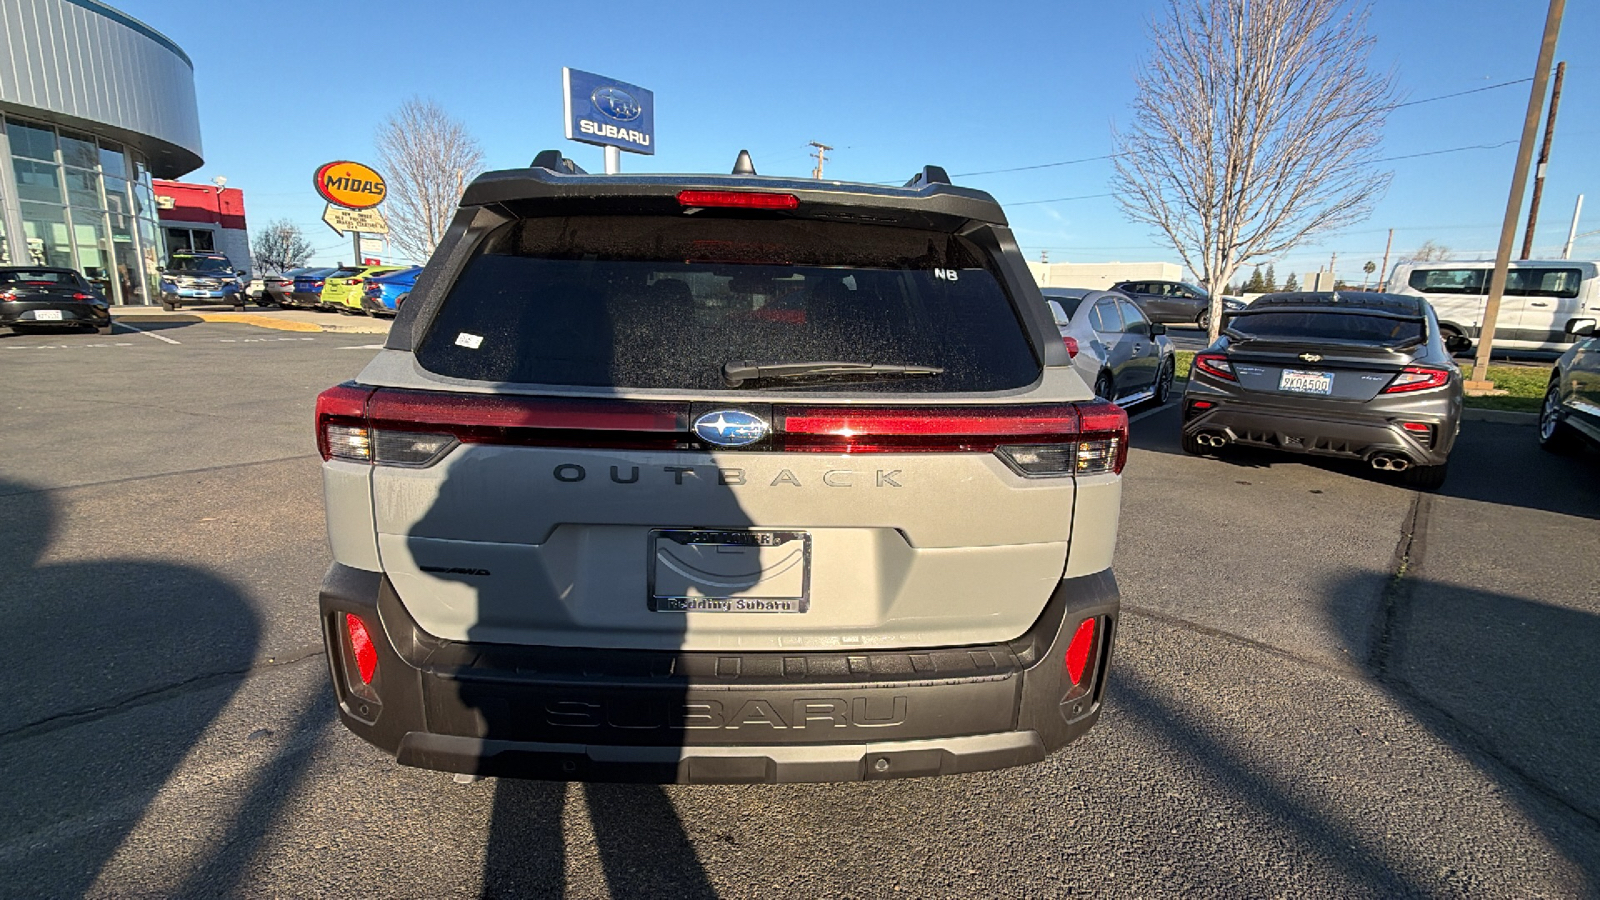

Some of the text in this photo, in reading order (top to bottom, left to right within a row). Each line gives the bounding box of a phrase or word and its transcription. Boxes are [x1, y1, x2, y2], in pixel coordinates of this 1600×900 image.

[580, 119, 649, 146] SUBARU
[326, 172, 384, 195] MIDAS
[553, 463, 902, 488] OUTBACK
[667, 598, 791, 611] Redding Subaru
[545, 696, 907, 730] SUBARU
